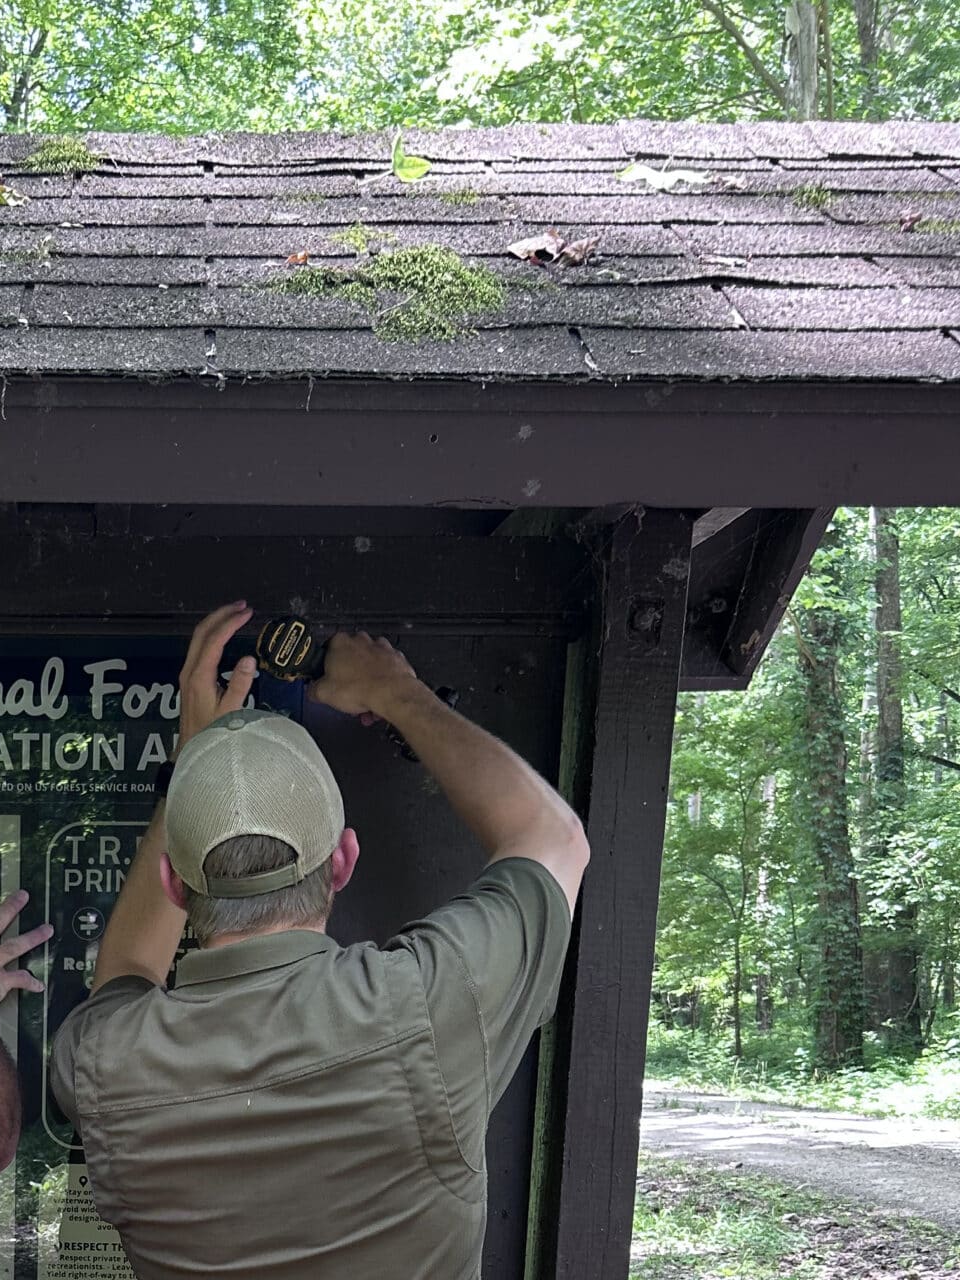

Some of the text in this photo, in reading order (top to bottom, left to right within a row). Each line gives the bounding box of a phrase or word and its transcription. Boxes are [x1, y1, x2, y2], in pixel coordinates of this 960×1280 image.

[17, 782, 32, 792] ON
[34, 783, 48, 792] US
[50, 783, 87, 792] FOREST
[89, 783, 128, 793] SERVICE
[64, 1242, 109, 1252] RESPECT
[59, 1254, 91, 1263] Respect
[93, 1255, 120, 1263] private
[68, 1271, 117, 1280] right-of-way
